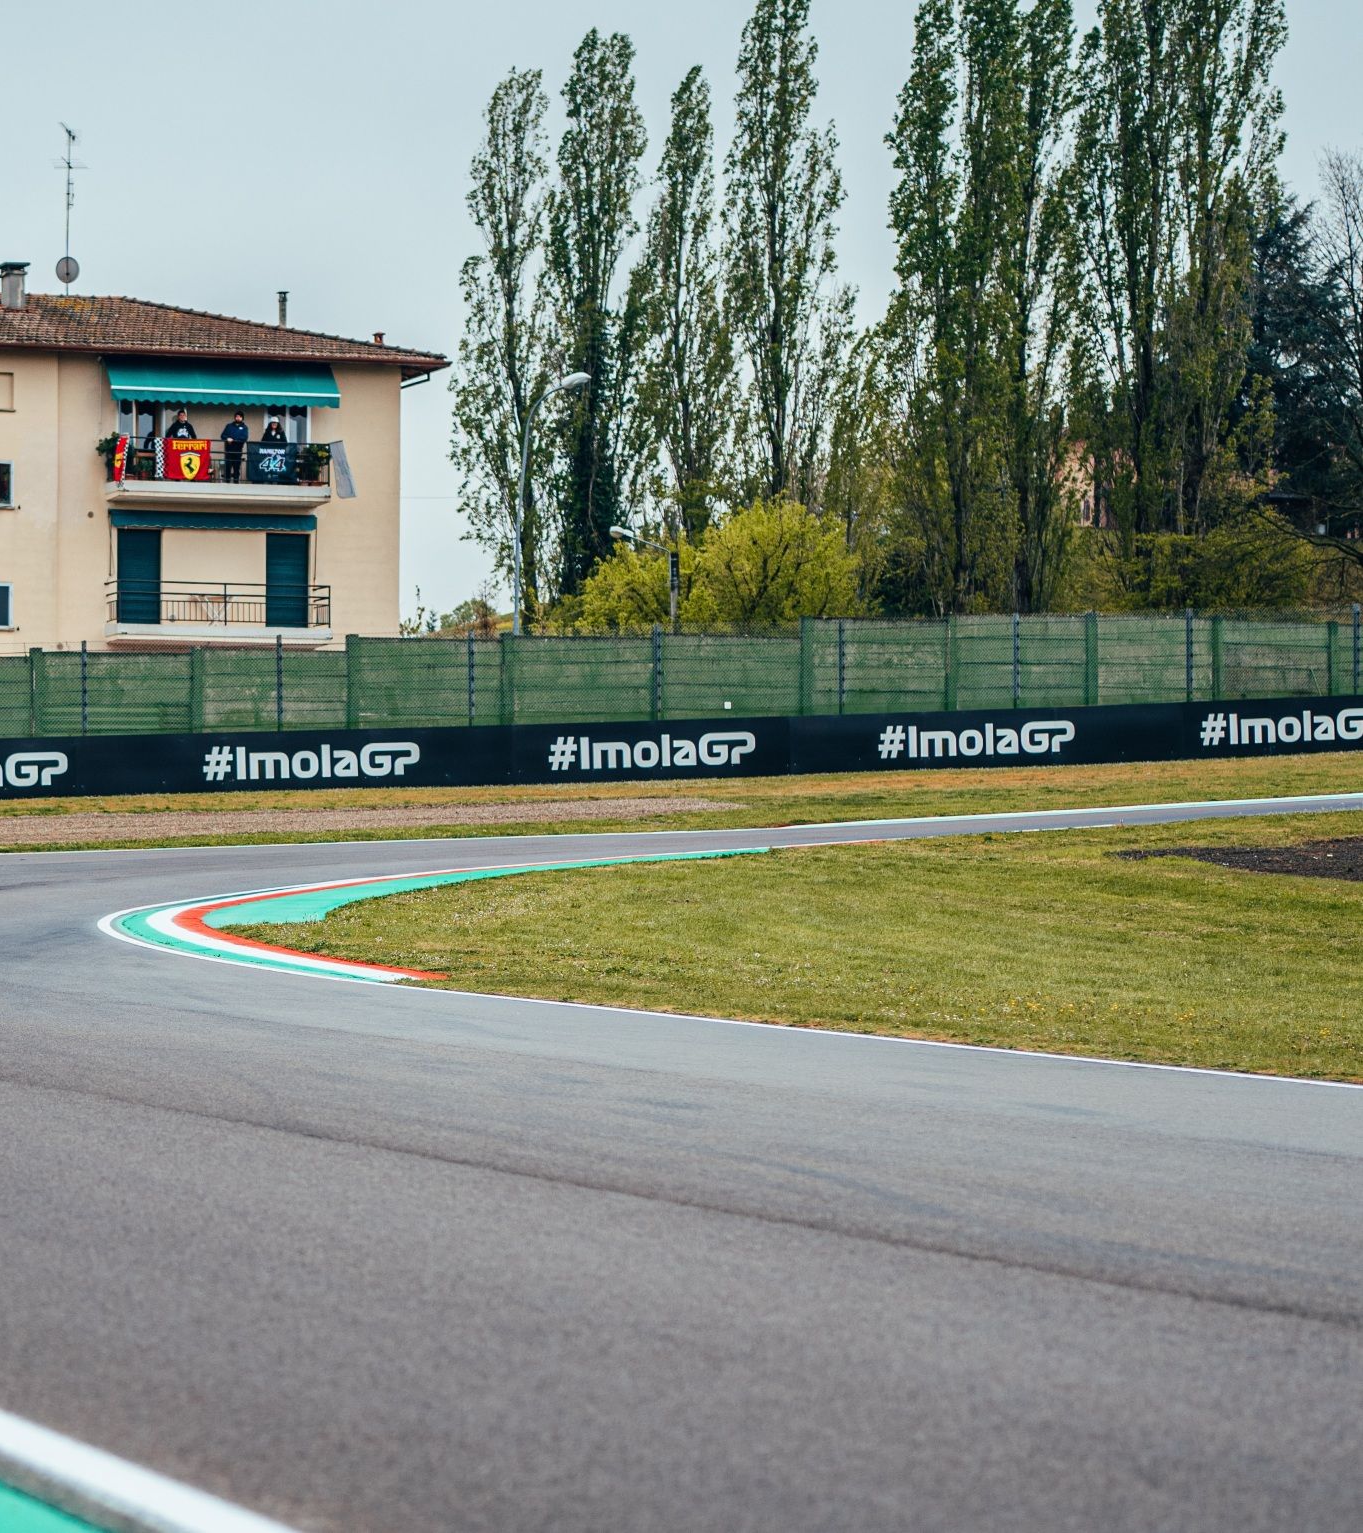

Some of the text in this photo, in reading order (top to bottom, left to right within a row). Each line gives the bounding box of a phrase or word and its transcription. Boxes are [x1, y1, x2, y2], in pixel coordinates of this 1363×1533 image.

[172, 440, 208, 450] Ferrari
[258, 455, 287, 472] 44
[878, 720, 1075, 759] #ImolaGP
[1200, 708, 1363, 746] #ImolaG
[202, 742, 420, 781] #ImolaGP
[548, 732, 756, 771] #ImolaGP
